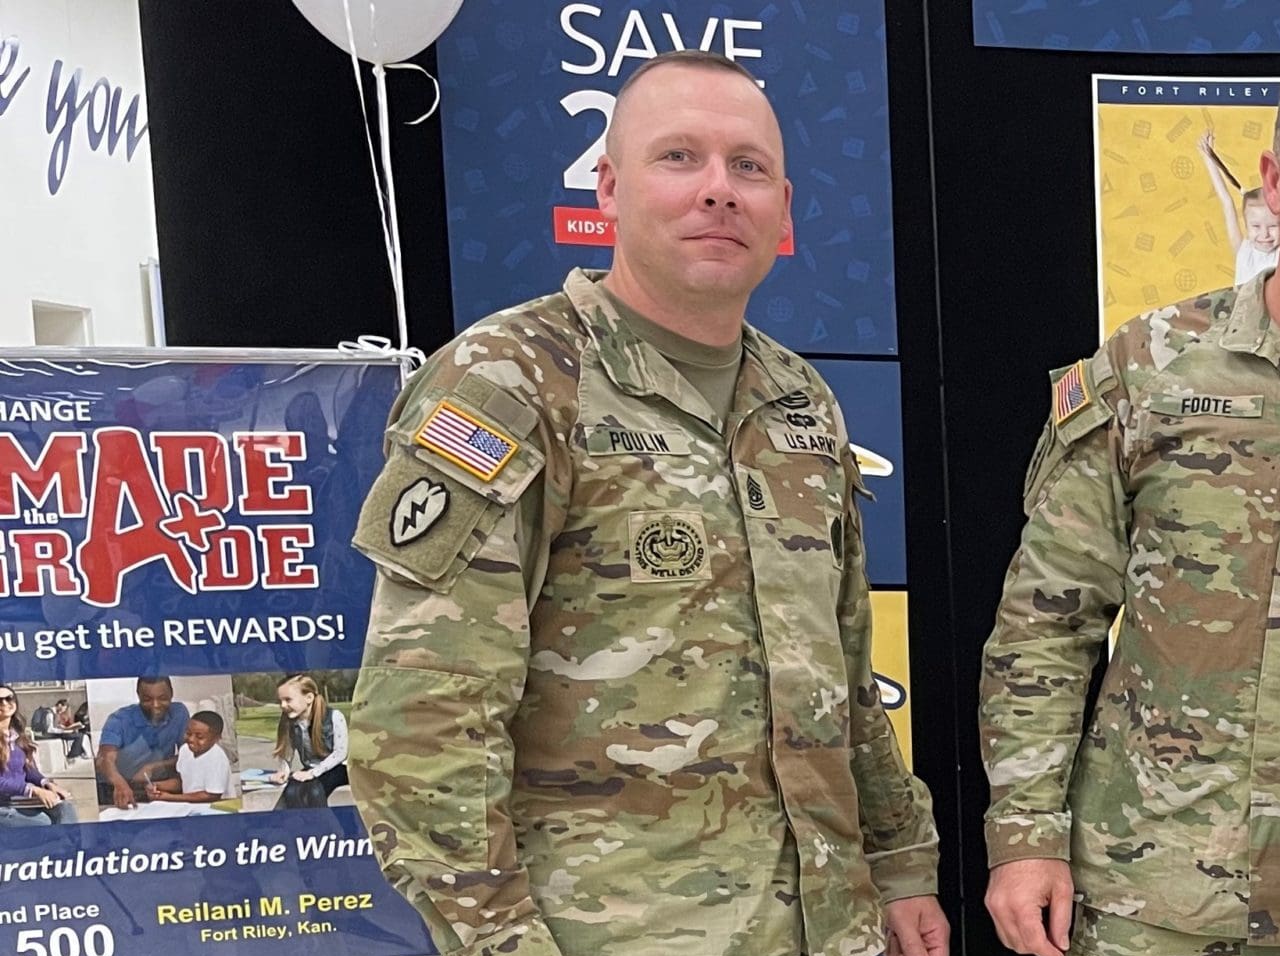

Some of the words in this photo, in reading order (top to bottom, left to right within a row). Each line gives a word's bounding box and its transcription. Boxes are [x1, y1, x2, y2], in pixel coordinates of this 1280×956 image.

[560, 3, 765, 88] SAVE
[1121, 86, 1180, 96] FORT
[1199, 87, 1269, 97] RILEY
[1181, 396, 1233, 415] FOOTE
[609, 431, 671, 452] POULIN
[23, 508, 59, 526] the
[0, 518, 320, 608] RADE
[34, 624, 92, 660] get
[97, 619, 155, 649] the
[163, 614, 347, 647] REWARDS!
[0, 848, 185, 883] ratulations
[193, 844, 227, 869] to
[235, 838, 287, 866] the
[35, 902, 101, 922] Place
[157, 898, 252, 926] Reilani
[259, 896, 291, 918] M.
[299, 892, 374, 914] Perez
[200, 927, 238, 943] Fort
[243, 923, 293, 940] Riley,
[297, 920, 338, 935] Kan.
